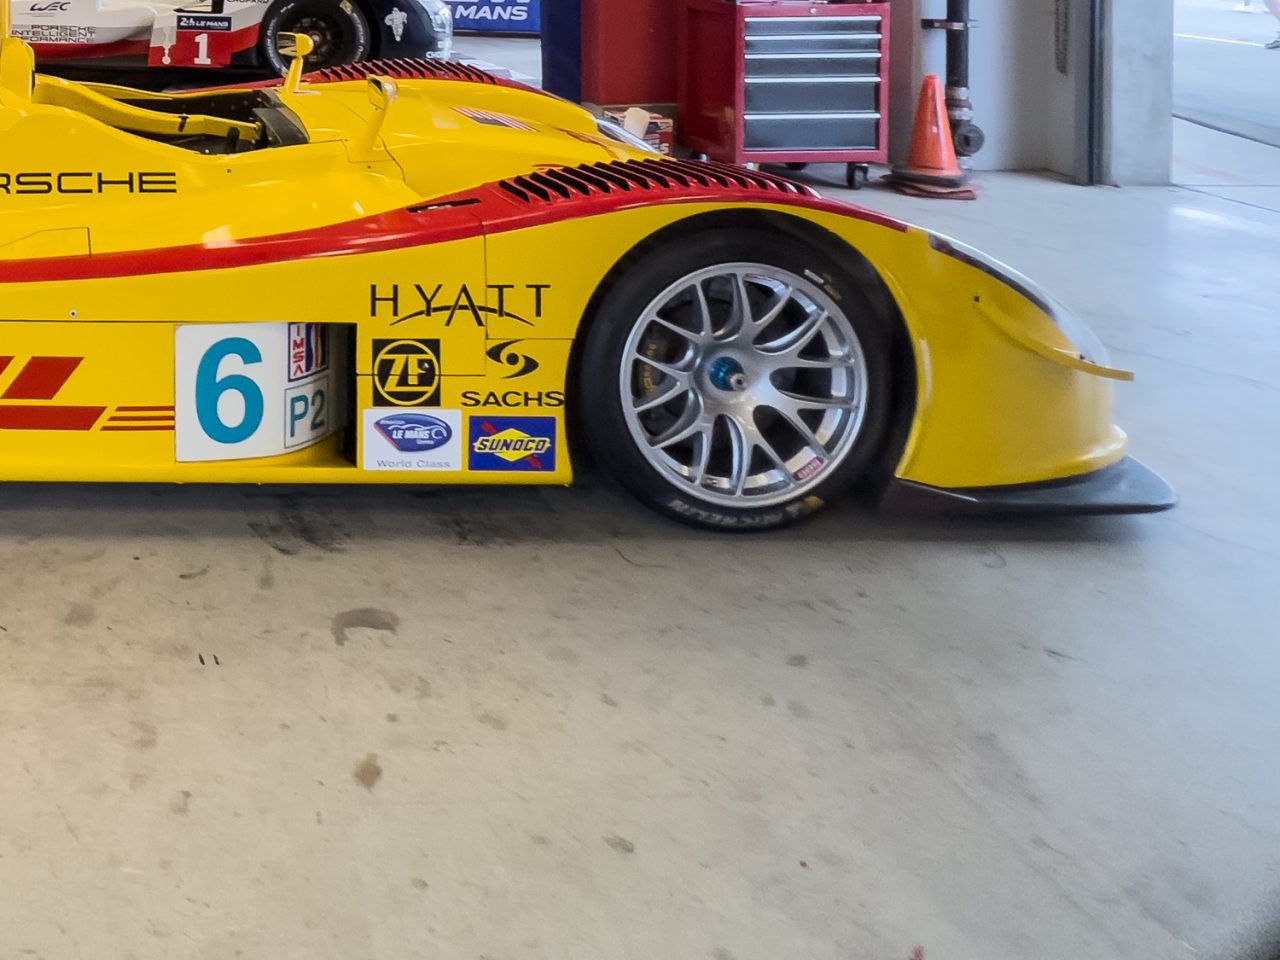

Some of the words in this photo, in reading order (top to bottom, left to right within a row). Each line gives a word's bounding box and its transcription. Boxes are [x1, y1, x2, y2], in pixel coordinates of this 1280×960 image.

[30, 1, 71, 11] WEC
[455, 5, 528, 21] MANS
[12, 30, 96, 38] INTELLIGENT
[193, 33, 212, 65] 1
[370, 283, 551, 327] HYATT
[380, 353, 434, 392] ZF
[195, 336, 264, 445] 6
[460, 391, 565, 407] SACHS
[290, 389, 325, 438] P2
[477, 438, 547, 452] SUNOCO
[377, 460, 412, 468] World
[416, 460, 451, 468] Class
